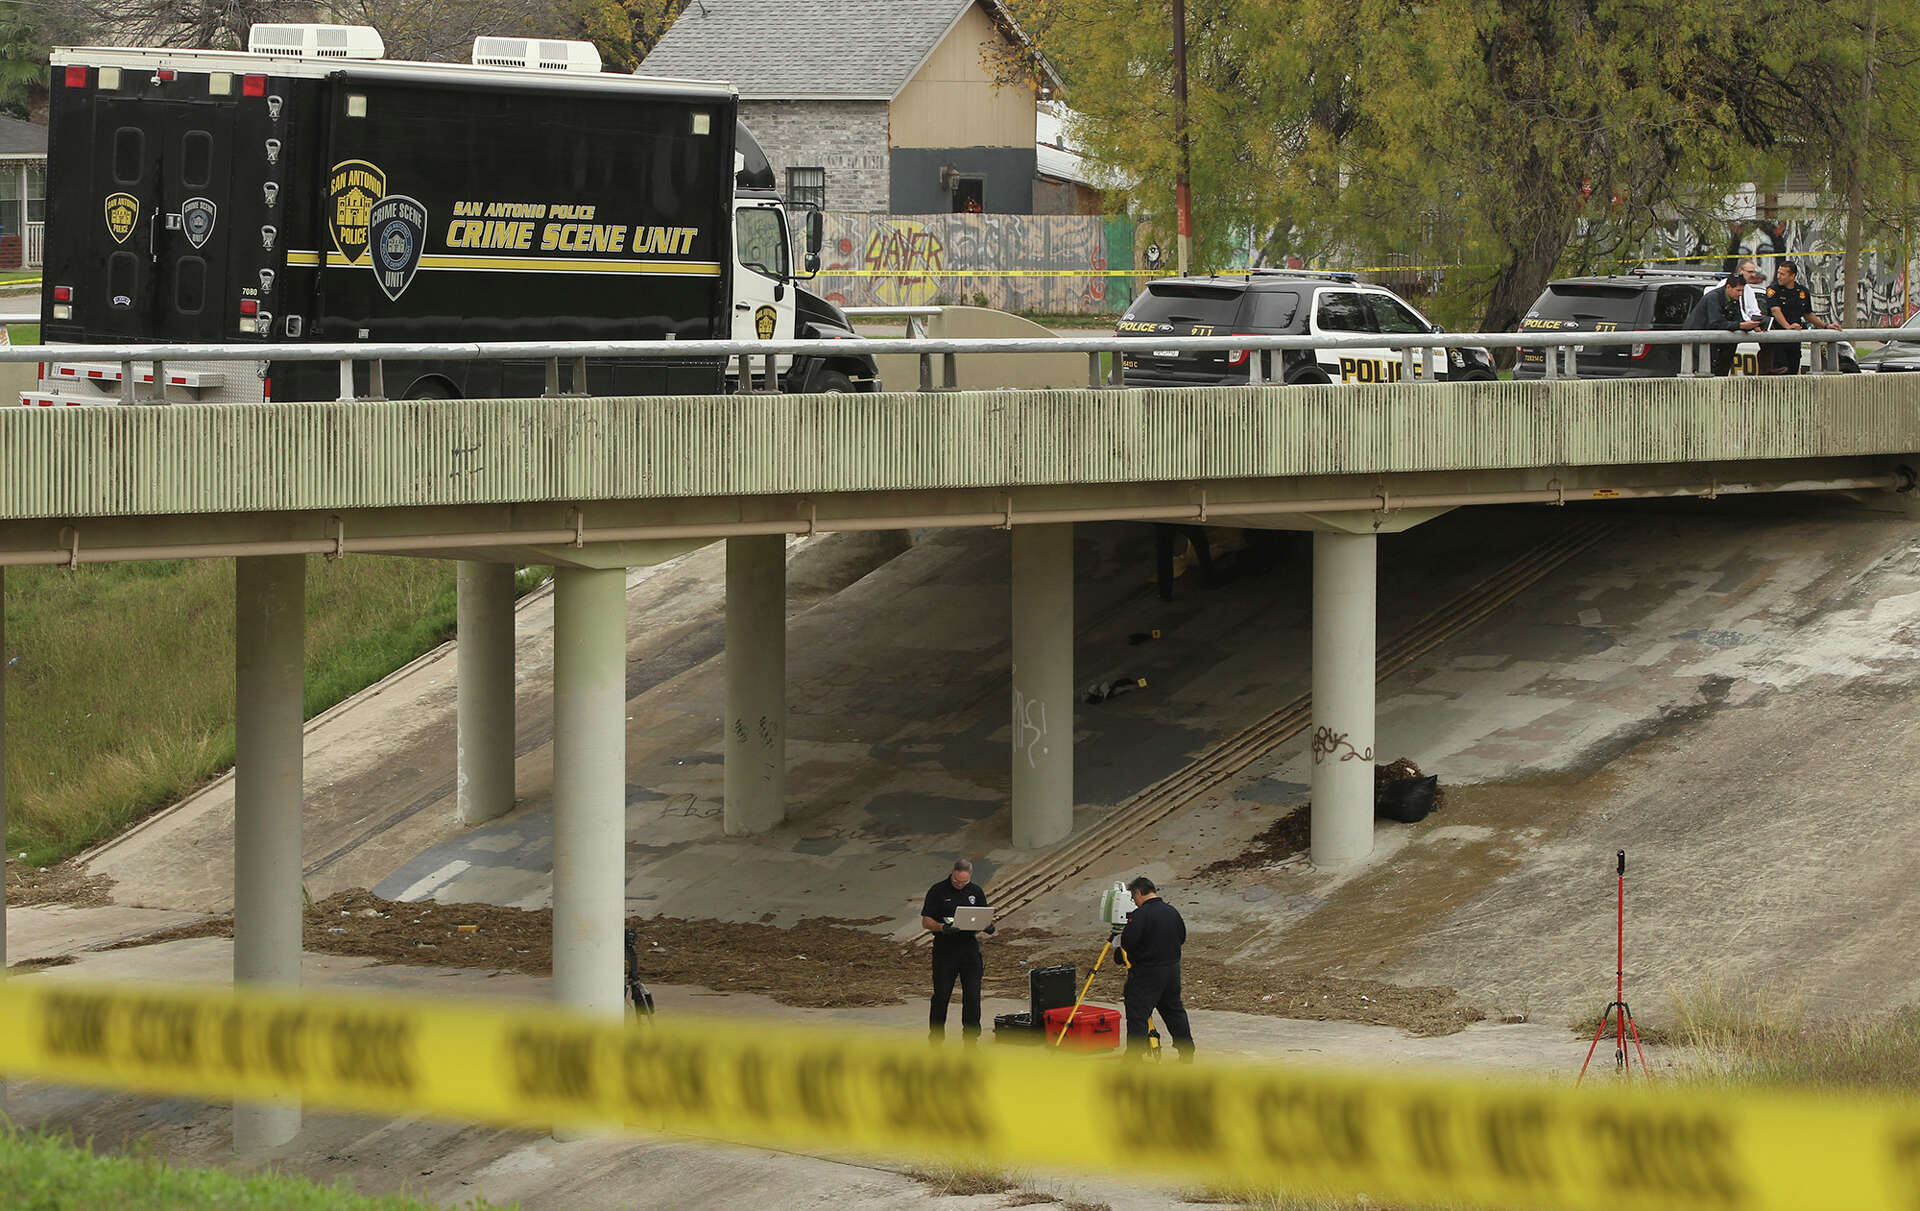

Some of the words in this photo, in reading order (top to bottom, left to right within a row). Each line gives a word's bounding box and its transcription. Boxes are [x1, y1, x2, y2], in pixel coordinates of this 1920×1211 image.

[330, 172, 347, 197] SAN
[347, 170, 381, 198] ANTONIO
[371, 202, 398, 228] CRIME
[398, 202, 422, 230] SCENE
[453, 202, 483, 217] SAN
[484, 203, 546, 219] ANTONIO
[549, 205, 596, 220] POLICE
[340, 227, 368, 245] POLICE
[446, 220, 535, 250] CRIME
[540, 223, 627, 253] SCENE
[632, 226, 698, 254] UNIT
[384, 271, 405, 288] UNIT
[1119, 321, 1158, 333] POLICE
[1524, 319, 1562, 329] POLICE
